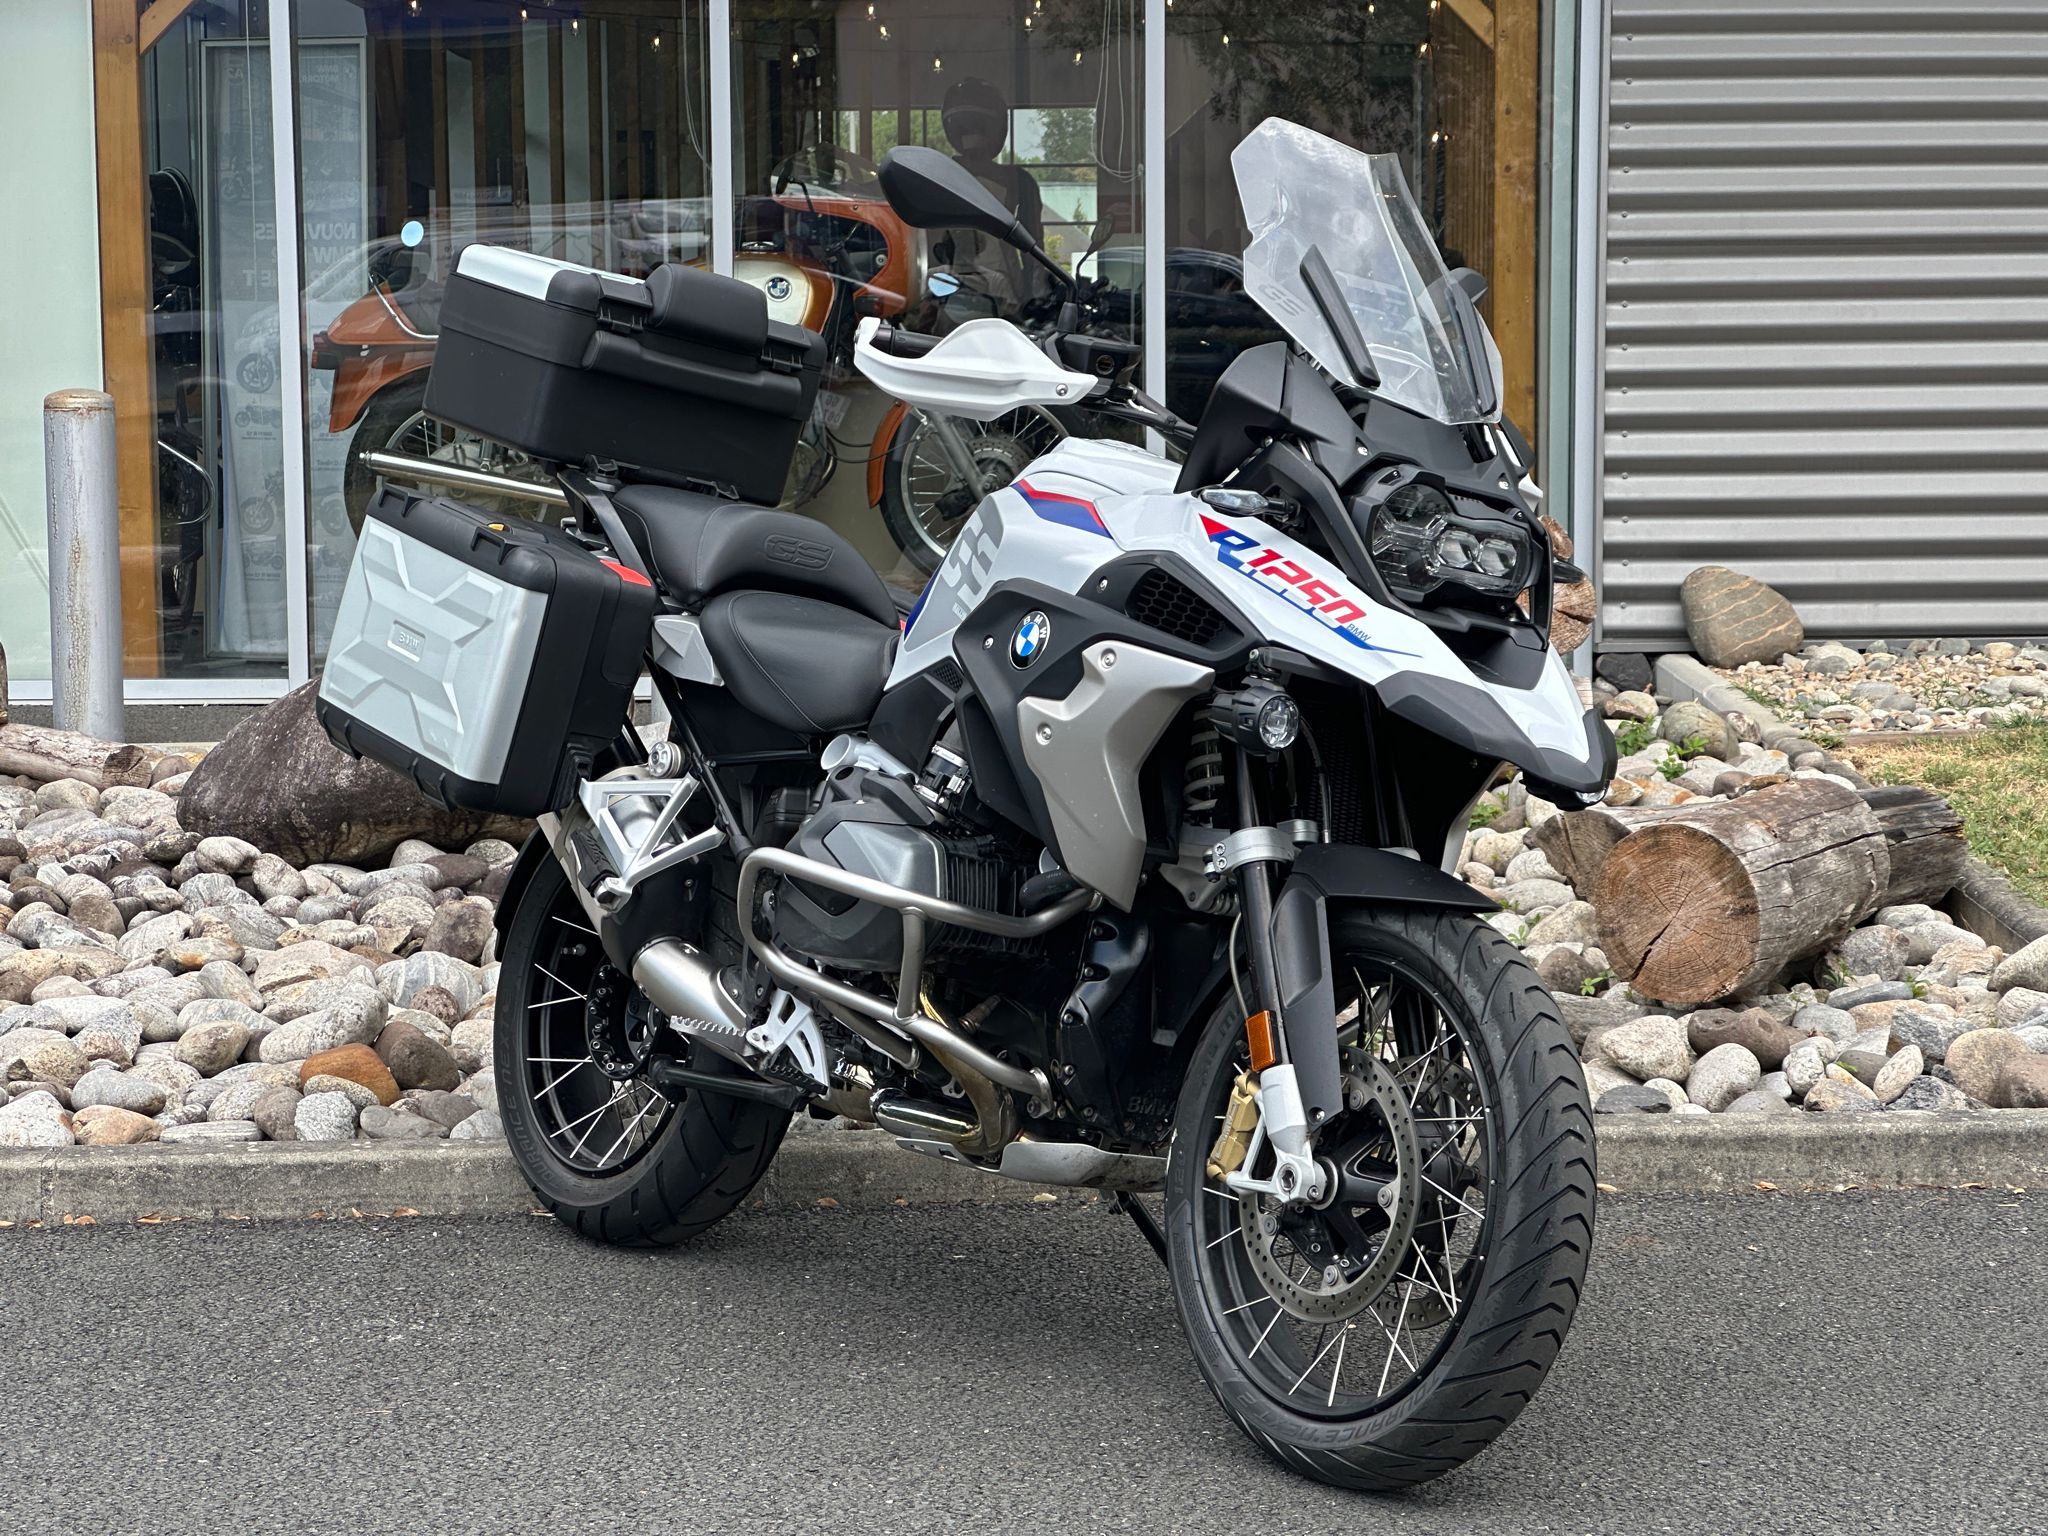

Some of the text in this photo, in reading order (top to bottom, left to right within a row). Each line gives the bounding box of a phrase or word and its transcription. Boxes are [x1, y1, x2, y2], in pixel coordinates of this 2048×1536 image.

[767, 537, 832, 569] GS
[1023, 614, 1048, 639] BMW
[1347, 623, 1372, 642] BMW
[1324, 1370, 1440, 1444] TOURANCE
